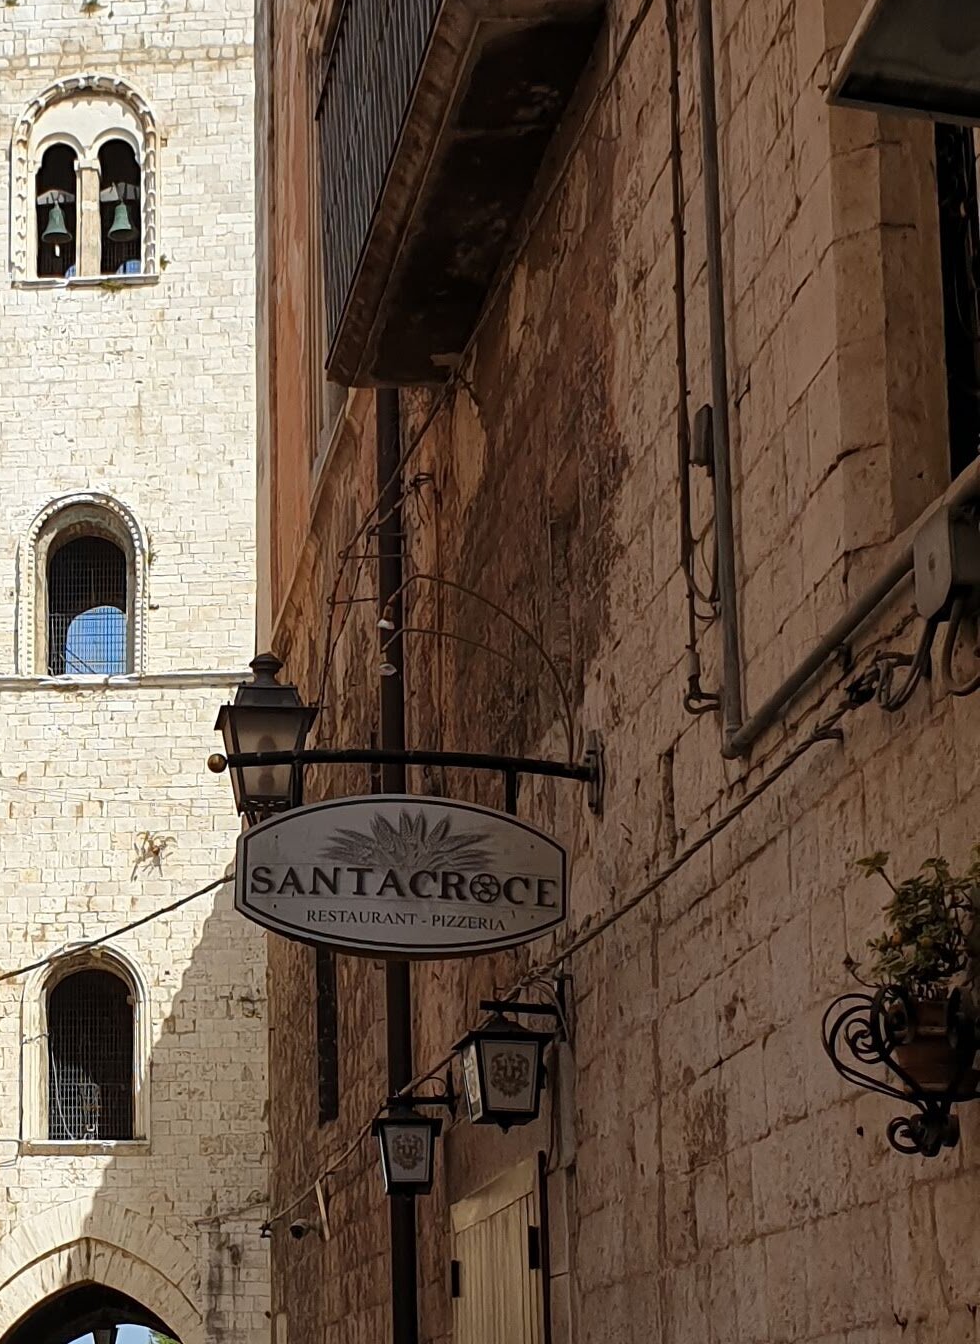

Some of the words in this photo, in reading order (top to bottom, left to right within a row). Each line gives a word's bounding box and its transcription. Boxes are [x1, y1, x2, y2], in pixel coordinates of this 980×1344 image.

[250, 865, 558, 908] SANTACROCE
[306, 909, 419, 927] RESTAURANT
[431, 913, 506, 931] PIZZERIA
